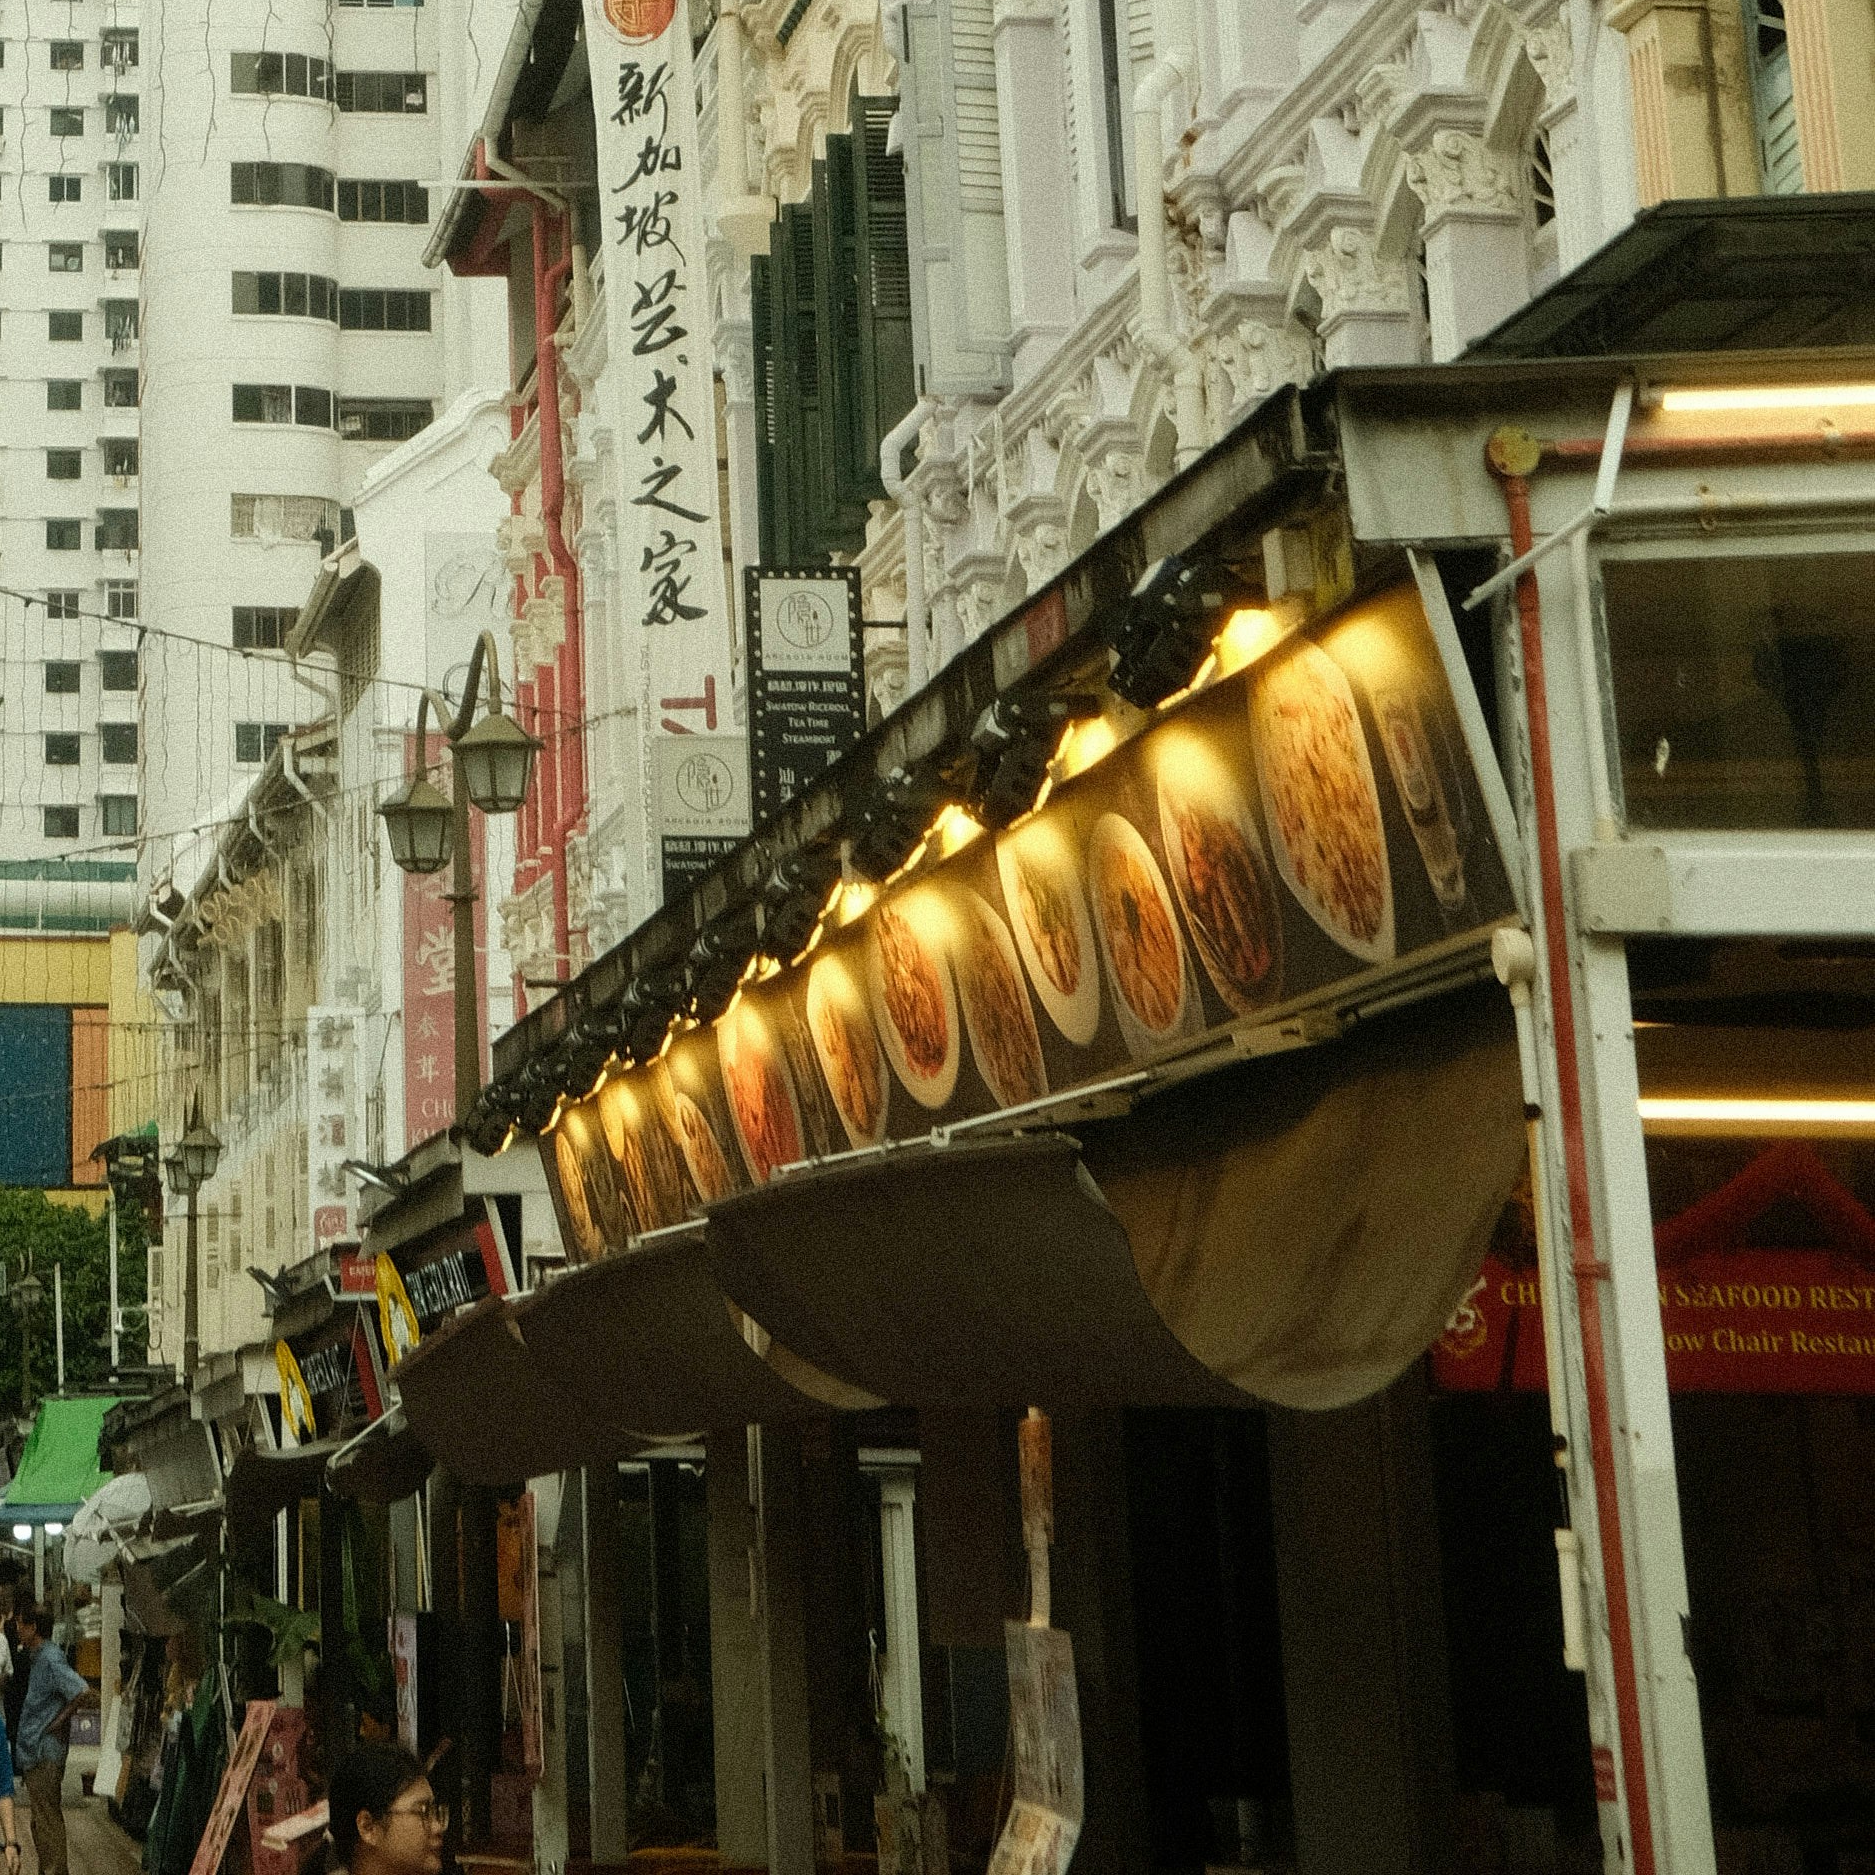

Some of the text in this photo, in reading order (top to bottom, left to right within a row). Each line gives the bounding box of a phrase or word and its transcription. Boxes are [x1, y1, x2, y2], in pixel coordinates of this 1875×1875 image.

[610, 62, 709, 626] 新加坡艺术之家
[1675, 1284, 1801, 1308] SEAFOOD
[1712, 1328, 1784, 1353] Chair
